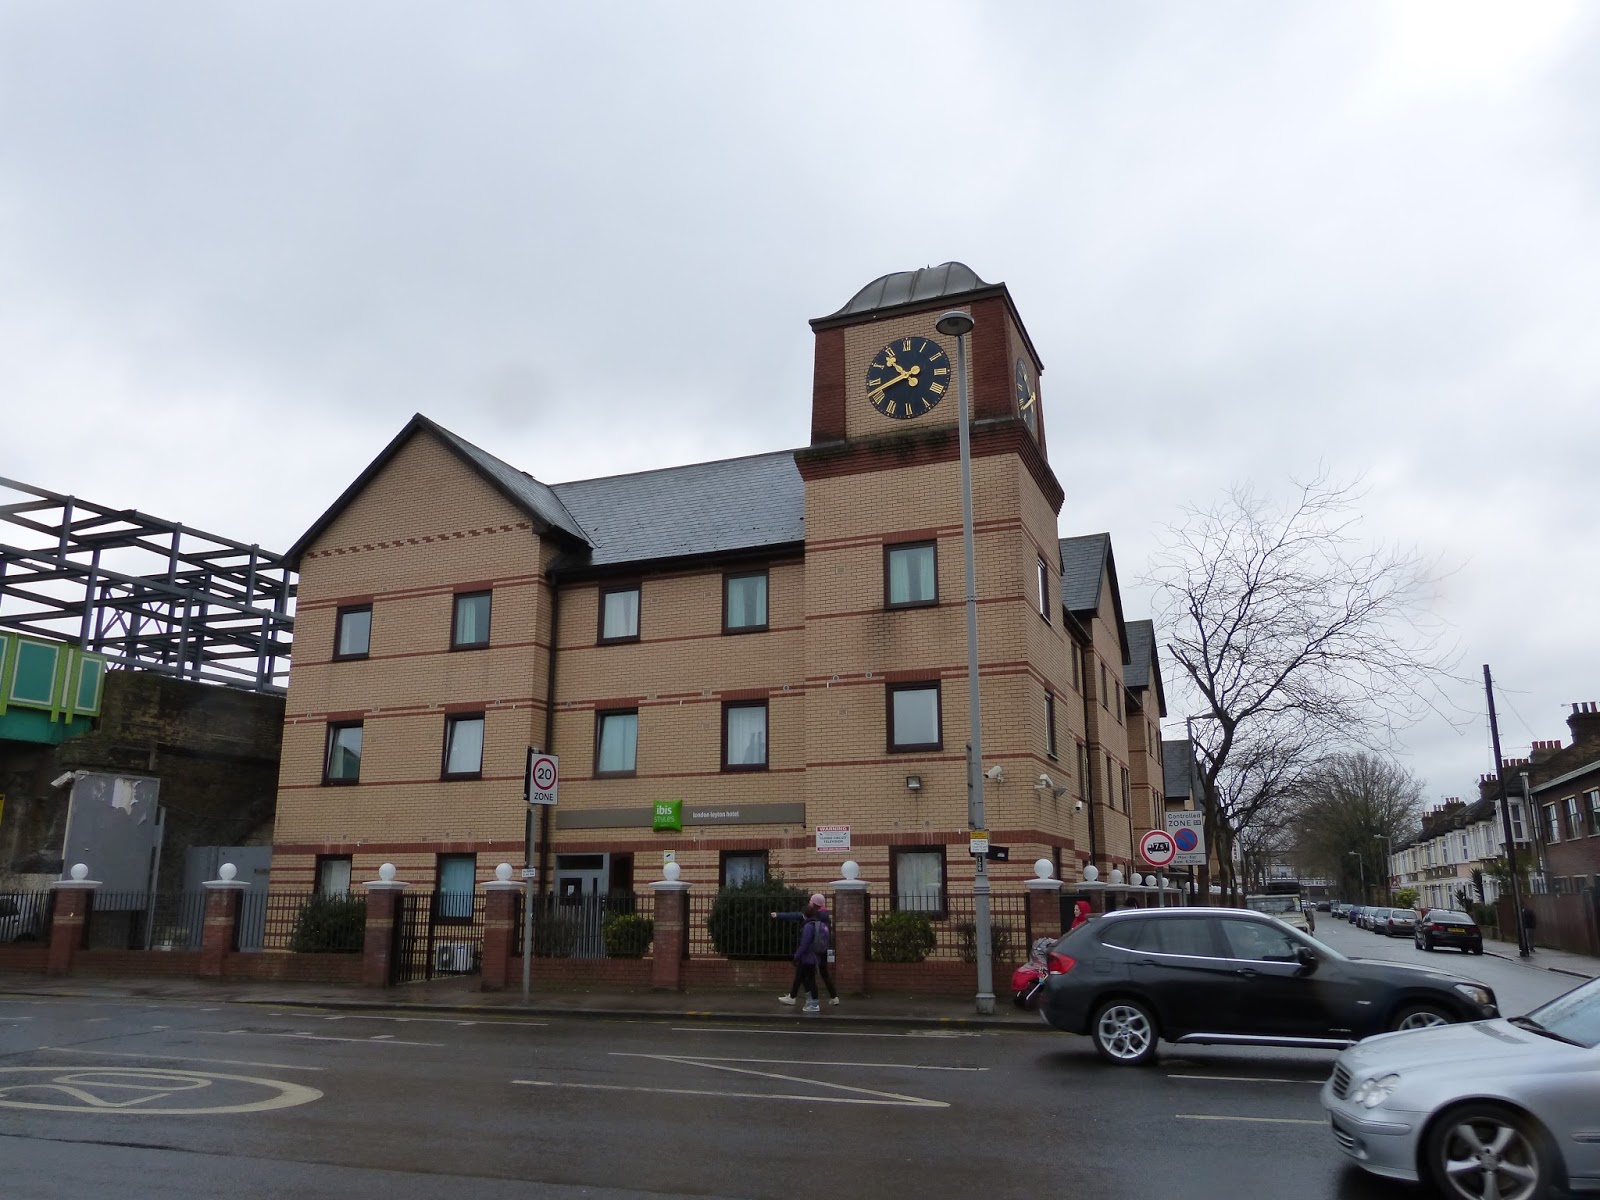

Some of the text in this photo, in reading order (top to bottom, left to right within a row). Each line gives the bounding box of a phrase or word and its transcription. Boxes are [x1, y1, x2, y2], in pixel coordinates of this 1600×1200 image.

[537, 768, 552, 780] 20
[534, 792, 554, 801] ZONE
[656, 805, 673, 815] ibis
